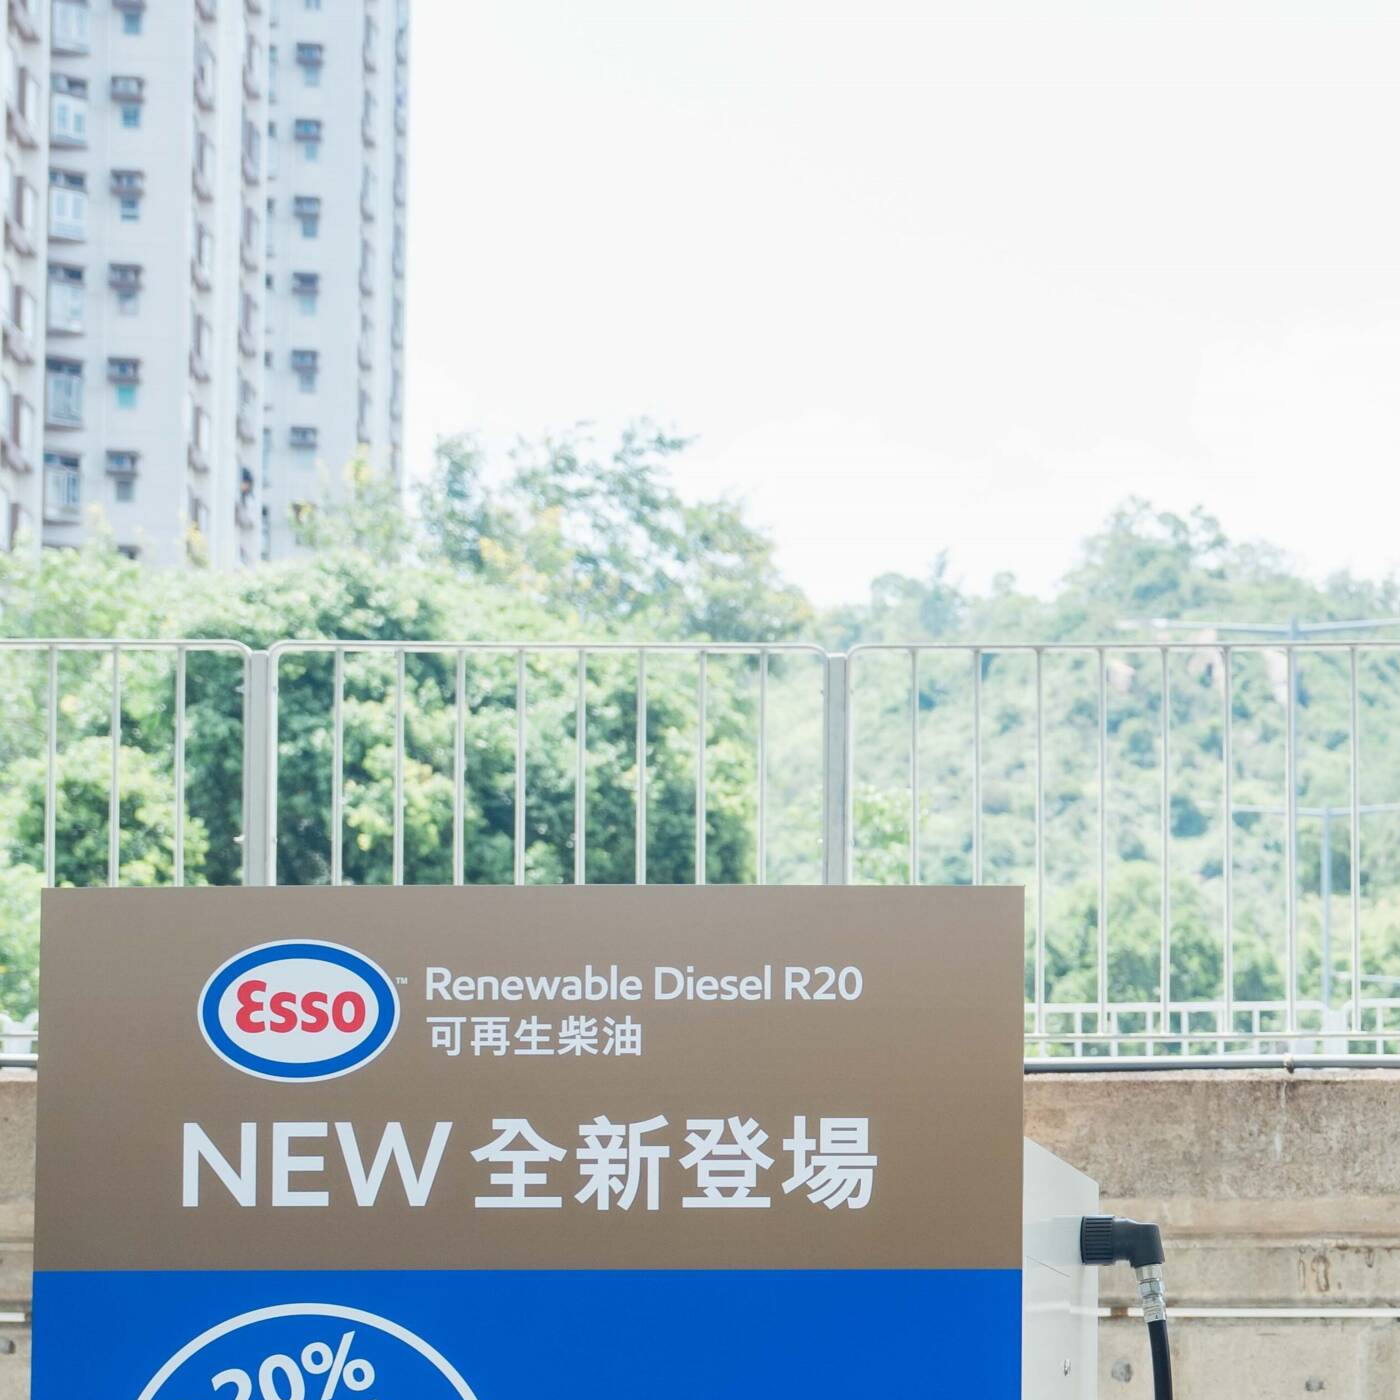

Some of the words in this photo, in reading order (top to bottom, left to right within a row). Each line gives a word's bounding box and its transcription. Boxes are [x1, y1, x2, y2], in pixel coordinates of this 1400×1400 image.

[235, 979, 366, 1034] Esso
[425, 964, 643, 1001] Renewable
[654, 964, 772, 1001] Diesel
[784, 965, 863, 1001] R20
[426, 1015, 642, 1057] 可再生柴油
[182, 1121, 454, 1208] NEW
[469, 1114, 878, 1211] 全新登場
